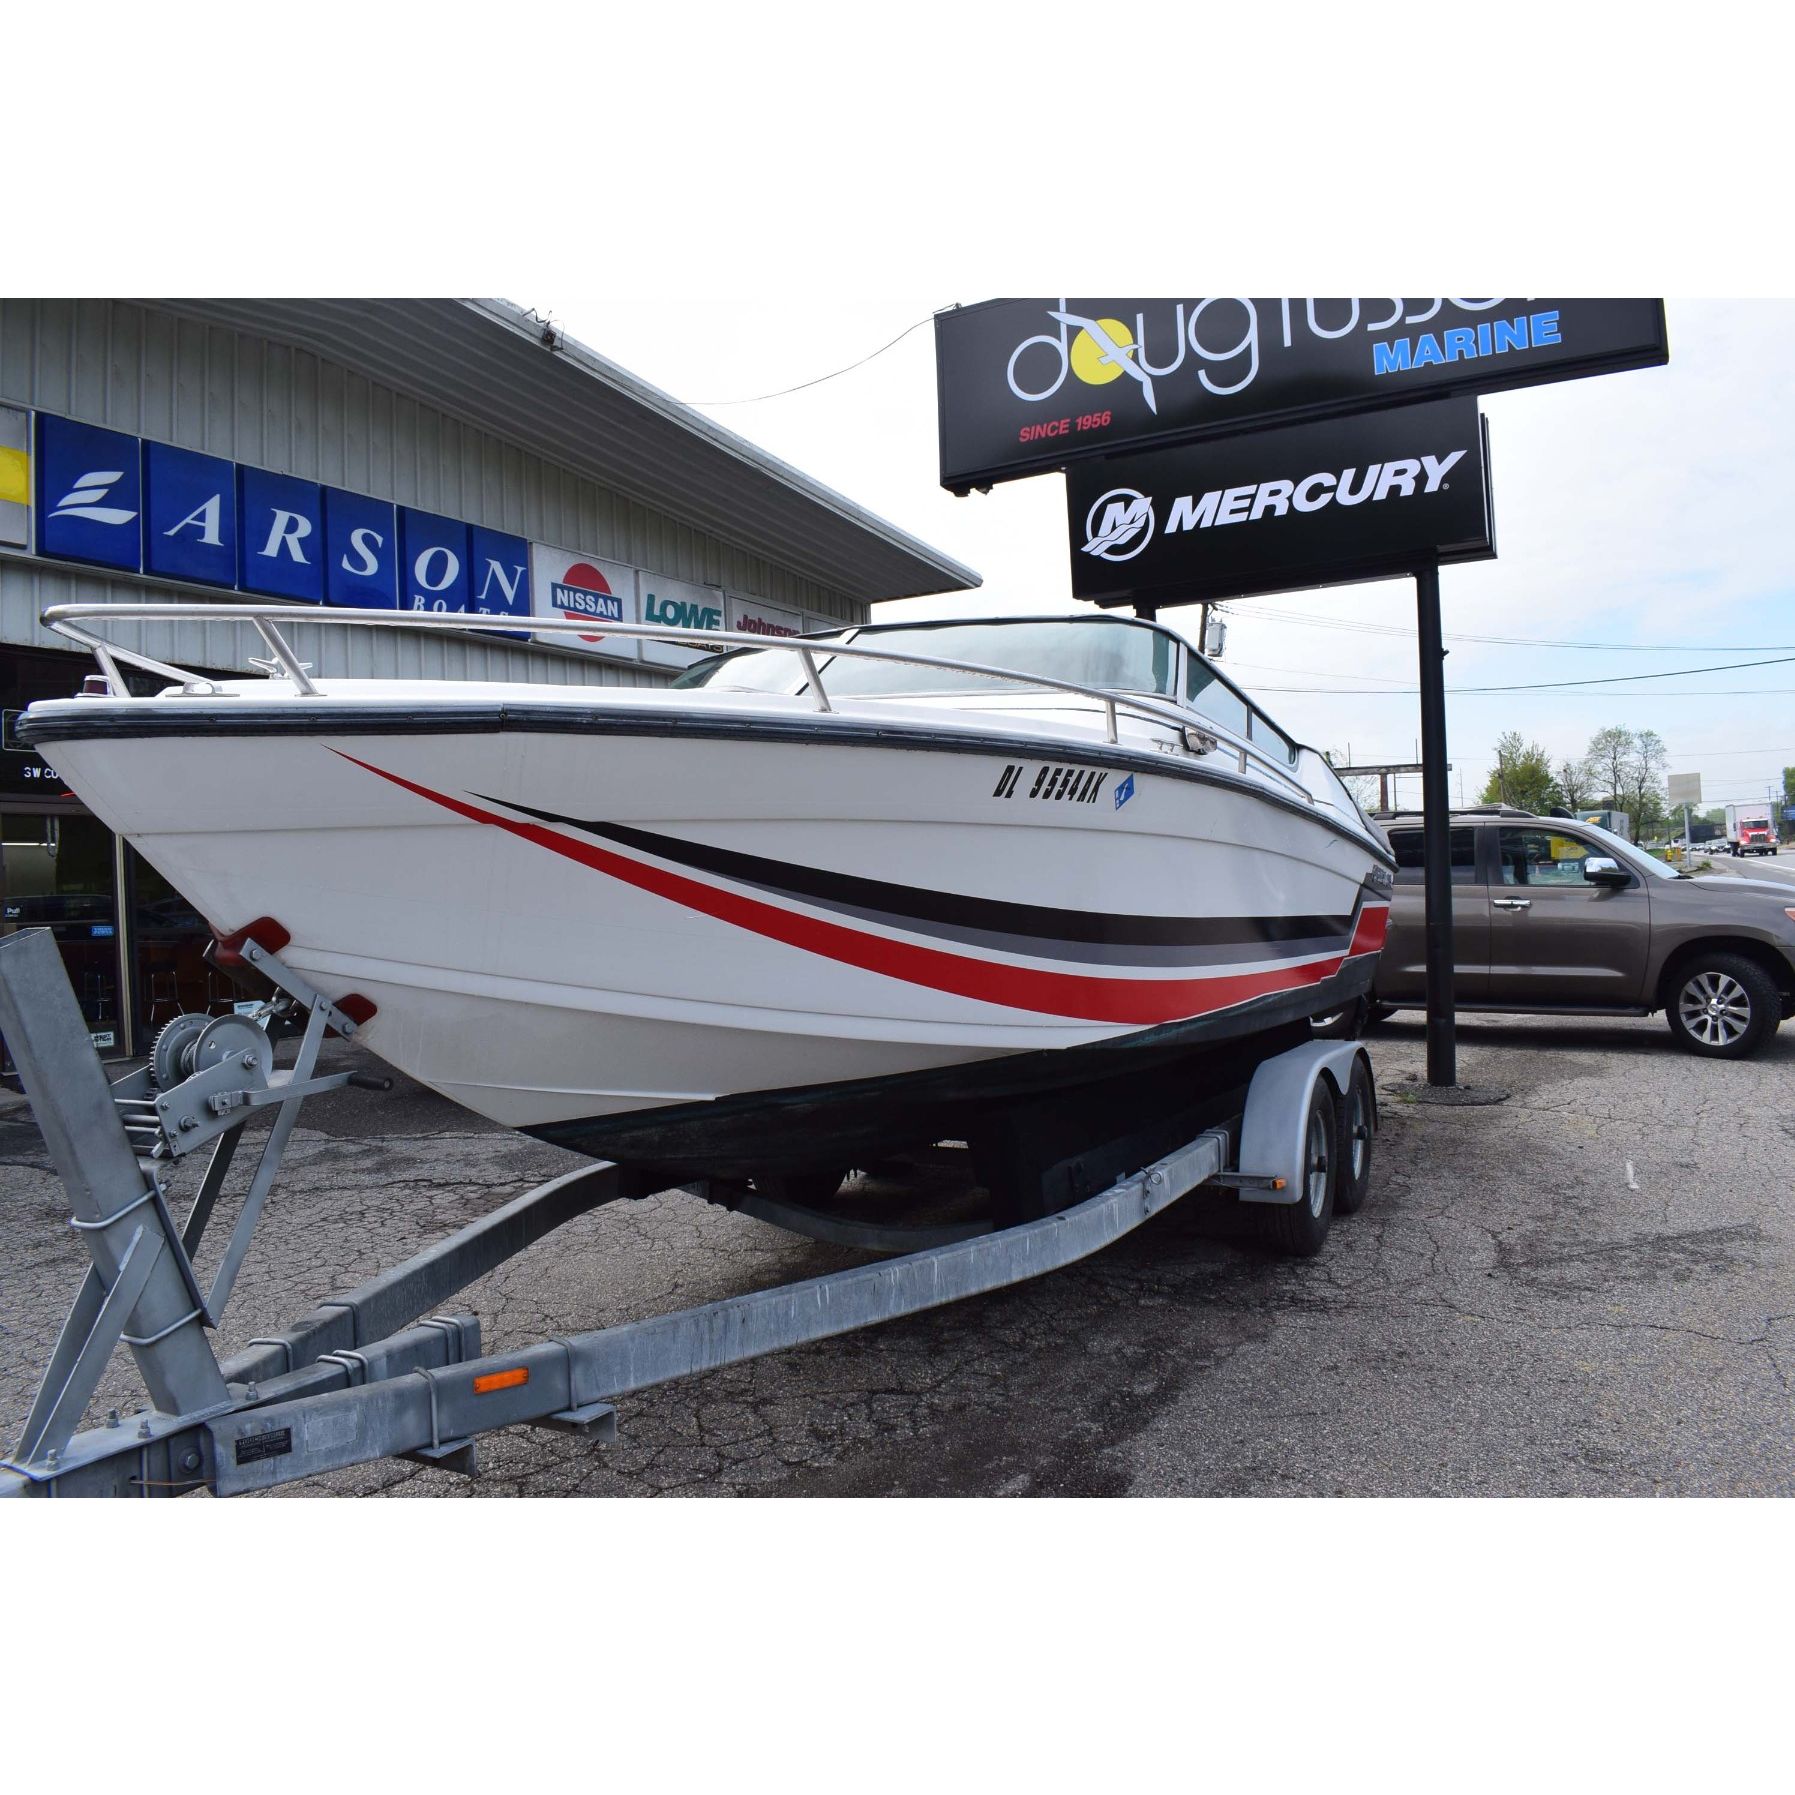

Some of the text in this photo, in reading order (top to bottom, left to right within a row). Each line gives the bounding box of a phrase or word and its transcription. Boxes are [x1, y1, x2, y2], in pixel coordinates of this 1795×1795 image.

[1373, 310, 1561, 376] MARINE
[1018, 410, 1112, 443] SINCE 1956
[1164, 450, 1468, 534] MERCURY
[413, 594, 509, 616] BOAT
[556, 588, 619, 618] NISSAN
[645, 593, 722, 632] LOWE
